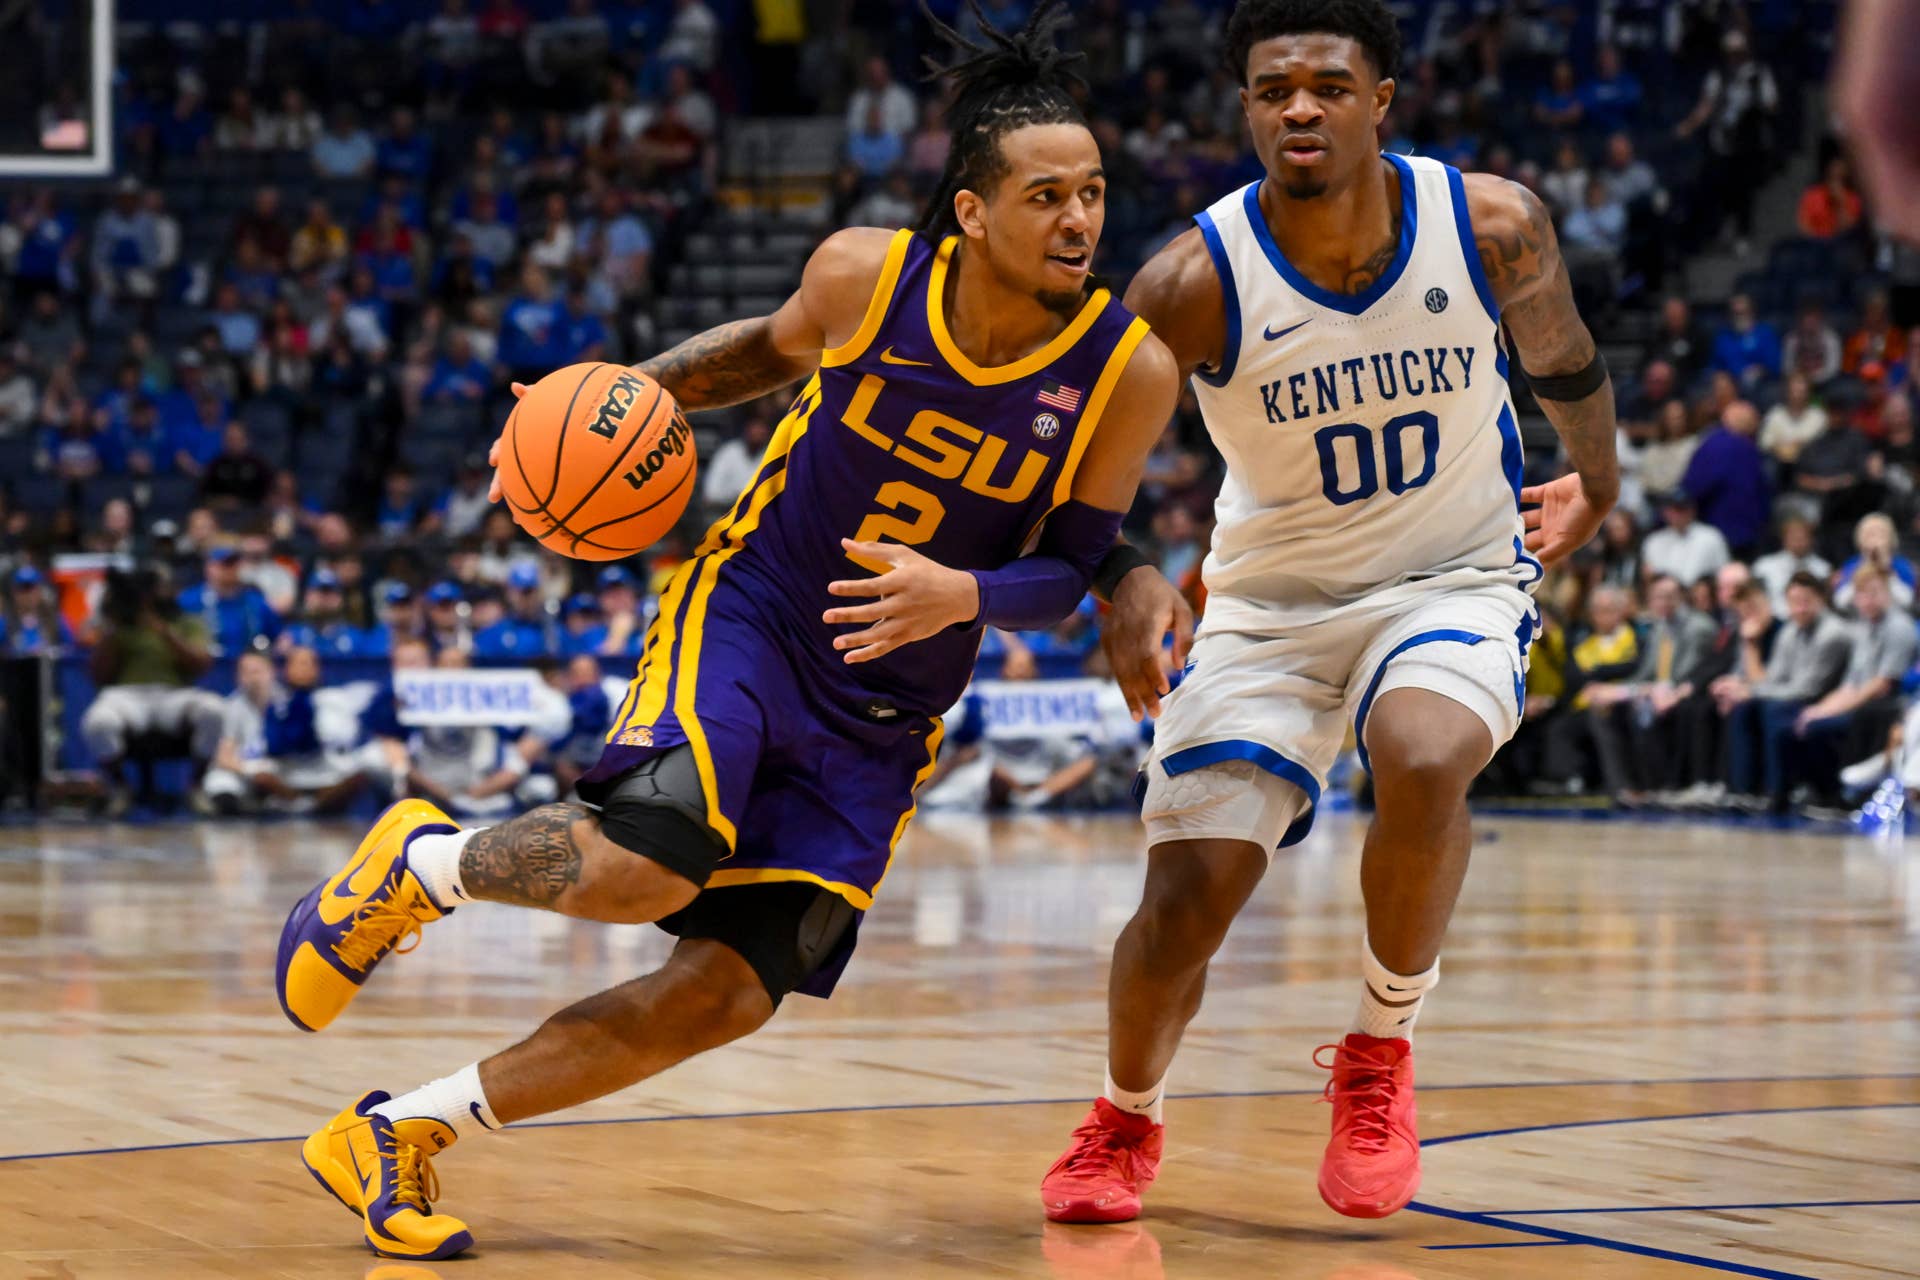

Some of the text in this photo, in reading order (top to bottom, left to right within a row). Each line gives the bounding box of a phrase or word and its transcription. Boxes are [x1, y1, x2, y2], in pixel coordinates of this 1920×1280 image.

[1426, 288, 1447, 312] SEC
[588, 371, 646, 440] NCAA
[1260, 347, 1475, 424] KENTUCKY
[840, 374, 1051, 503] LSU
[1034, 414, 1058, 438] SEC
[1313, 410, 1440, 506] 00
[845, 480, 947, 577] 2
